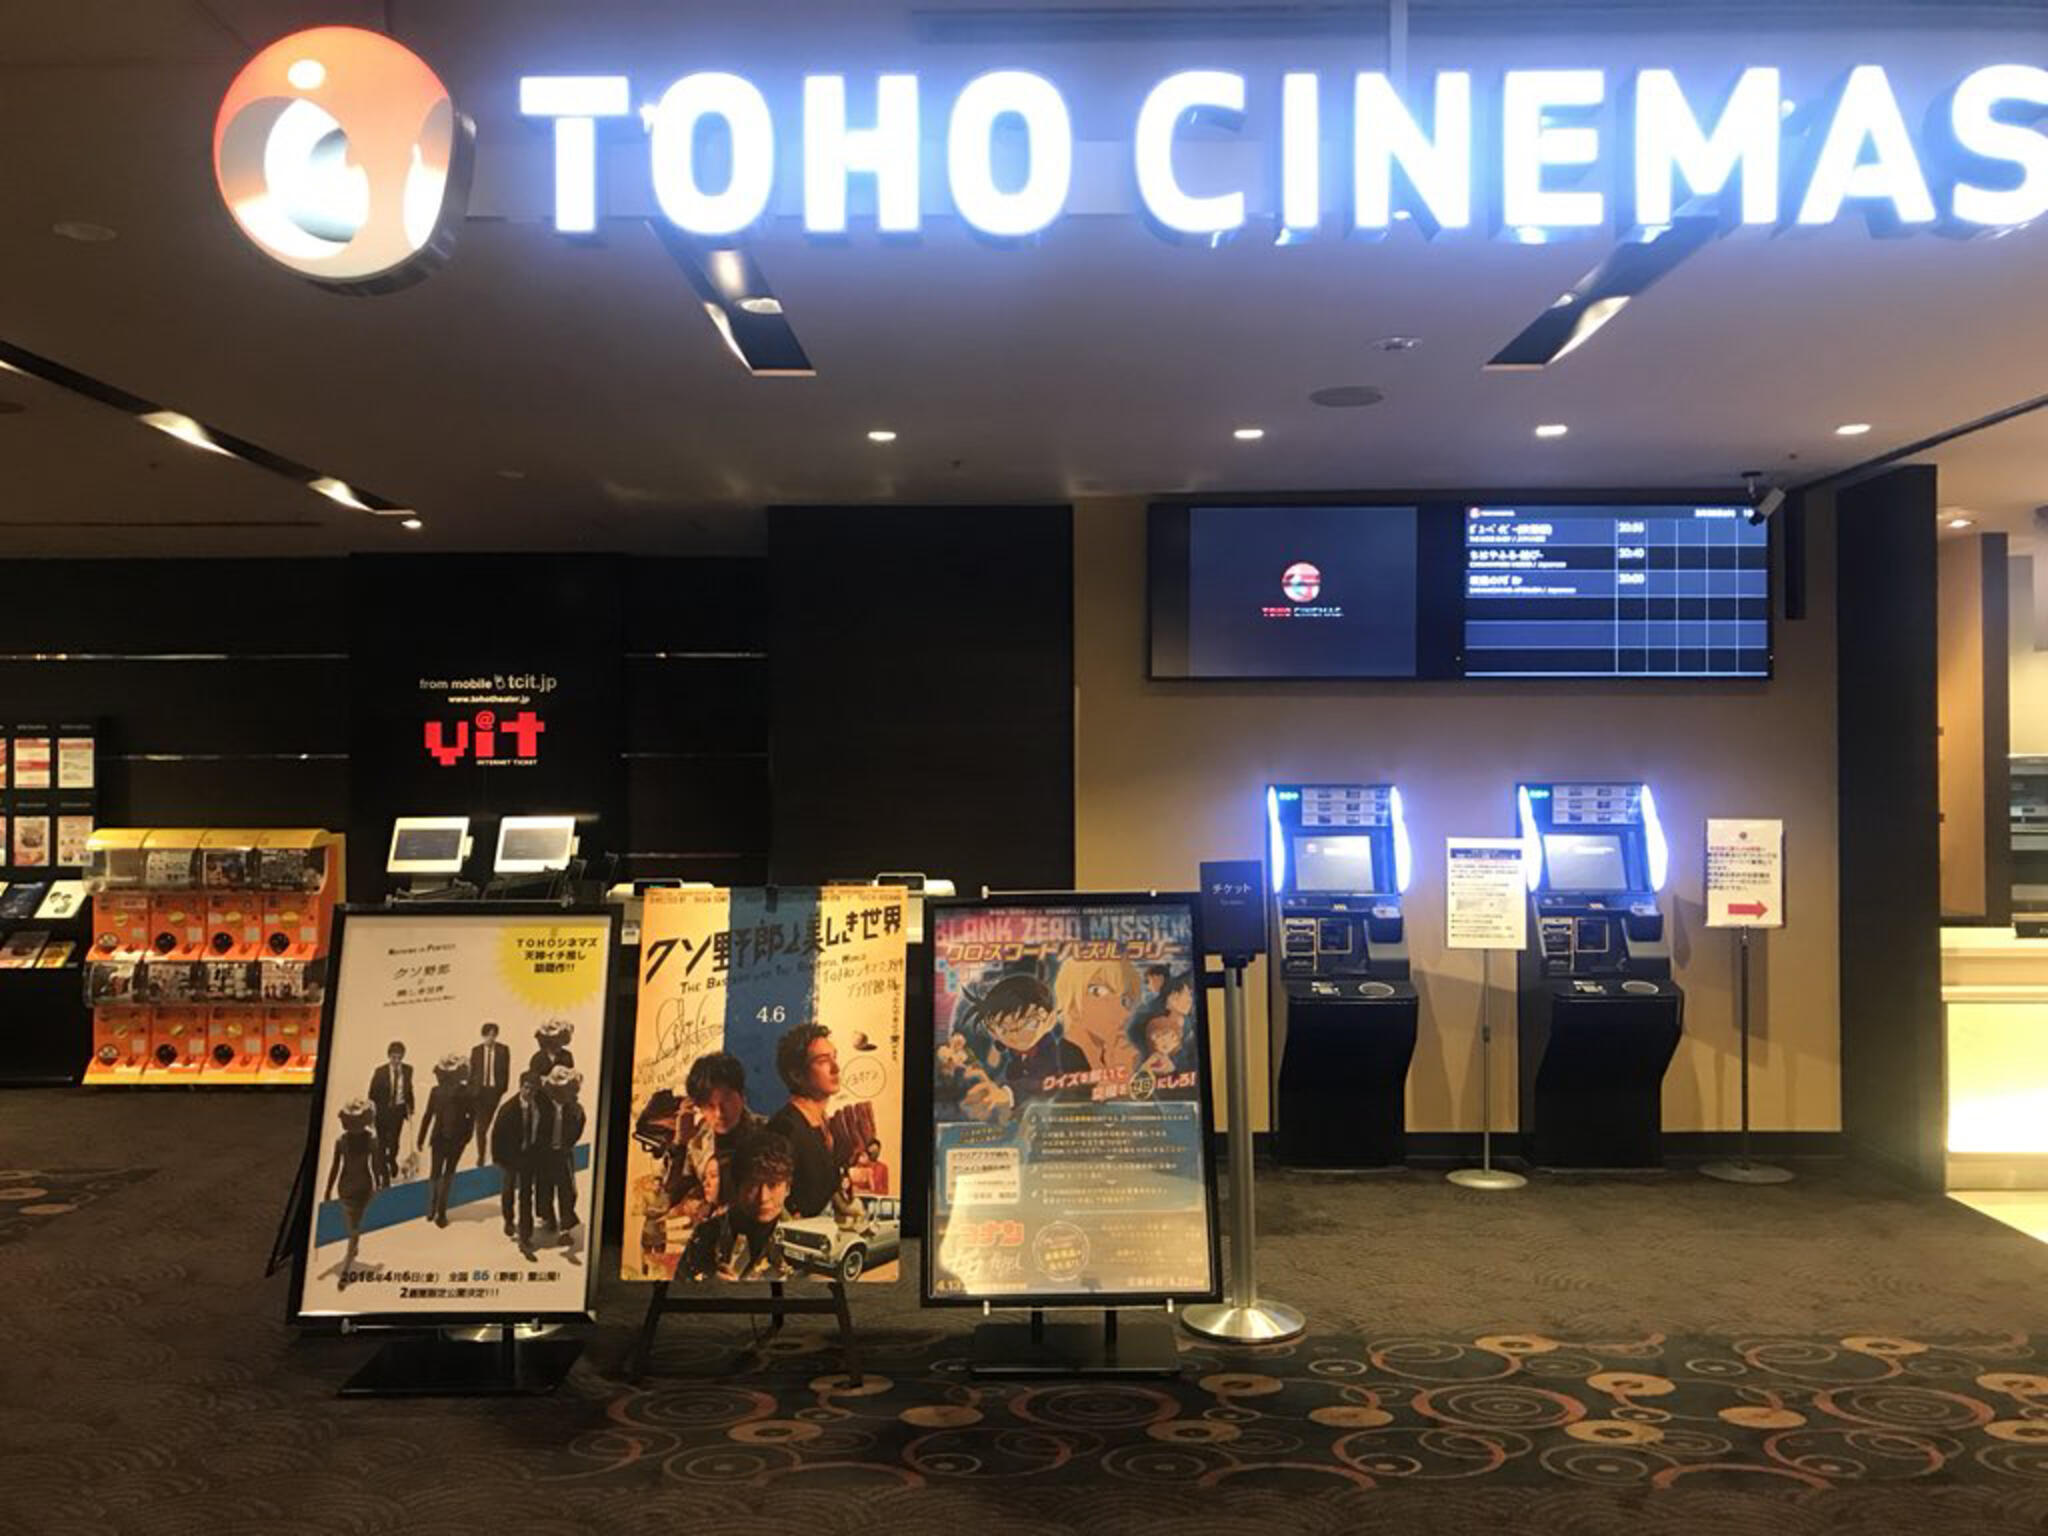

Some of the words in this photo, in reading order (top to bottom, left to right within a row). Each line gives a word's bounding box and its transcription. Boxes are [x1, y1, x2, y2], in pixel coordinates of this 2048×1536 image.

[520, 71, 1072, 236] TOHO
[1134, 64, 2048, 234] CINEMAS
[419, 677, 449, 690] from
[451, 677, 493, 690] mobile
[508, 673, 558, 693] tcit.jp
[1212, 882, 1252, 895] チケット
[1021, 914, 1081, 942] ZERO
[516, 937, 598, 948] TOHOシネマズ
[756, 1006, 786, 1023] 4.6
